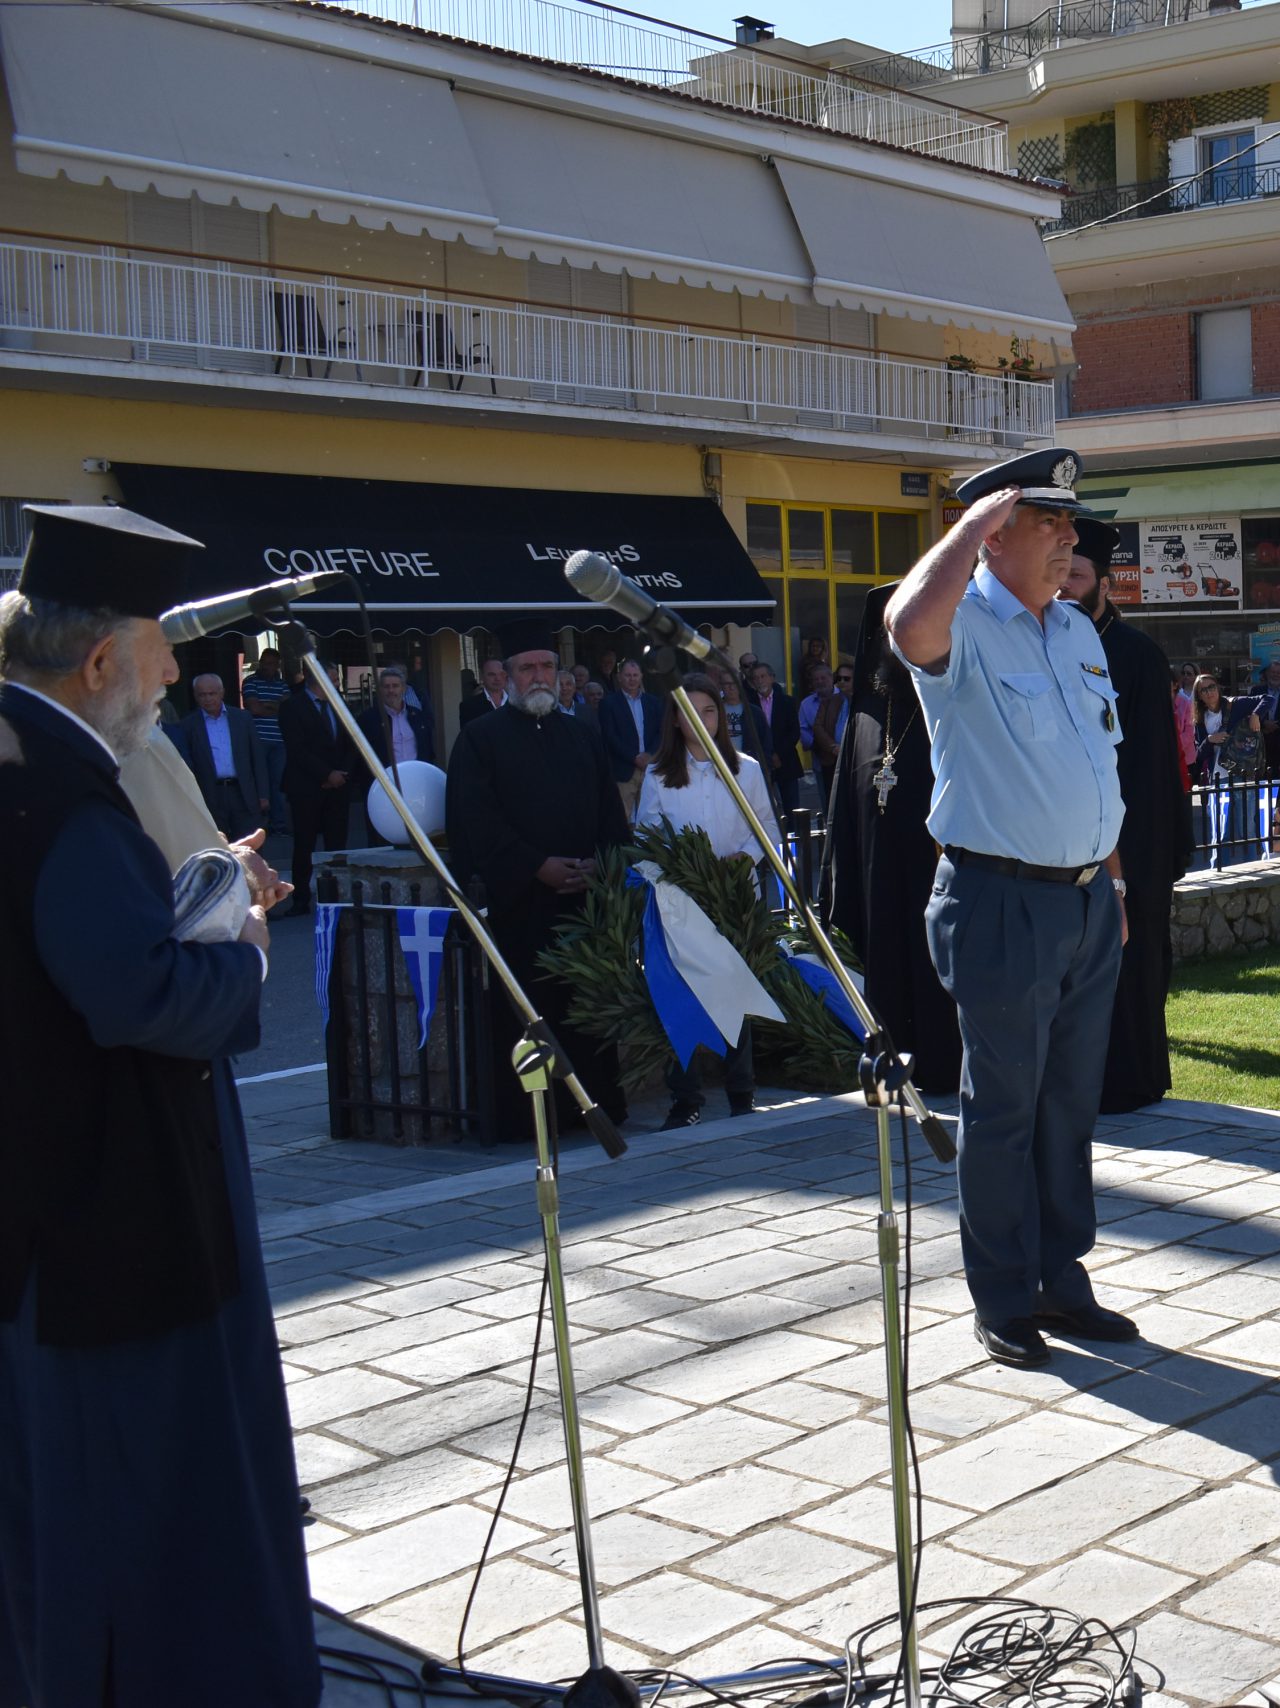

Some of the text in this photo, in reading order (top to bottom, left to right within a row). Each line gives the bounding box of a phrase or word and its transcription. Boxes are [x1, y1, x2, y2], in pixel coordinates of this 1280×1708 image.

[1151, 524, 1188, 533] ΑΠΟΣΥΡΕΤΕ
[1196, 523, 1227, 531] ΚΕΡΔΙΣΤΕ
[263, 548, 440, 576] COIFFURE
